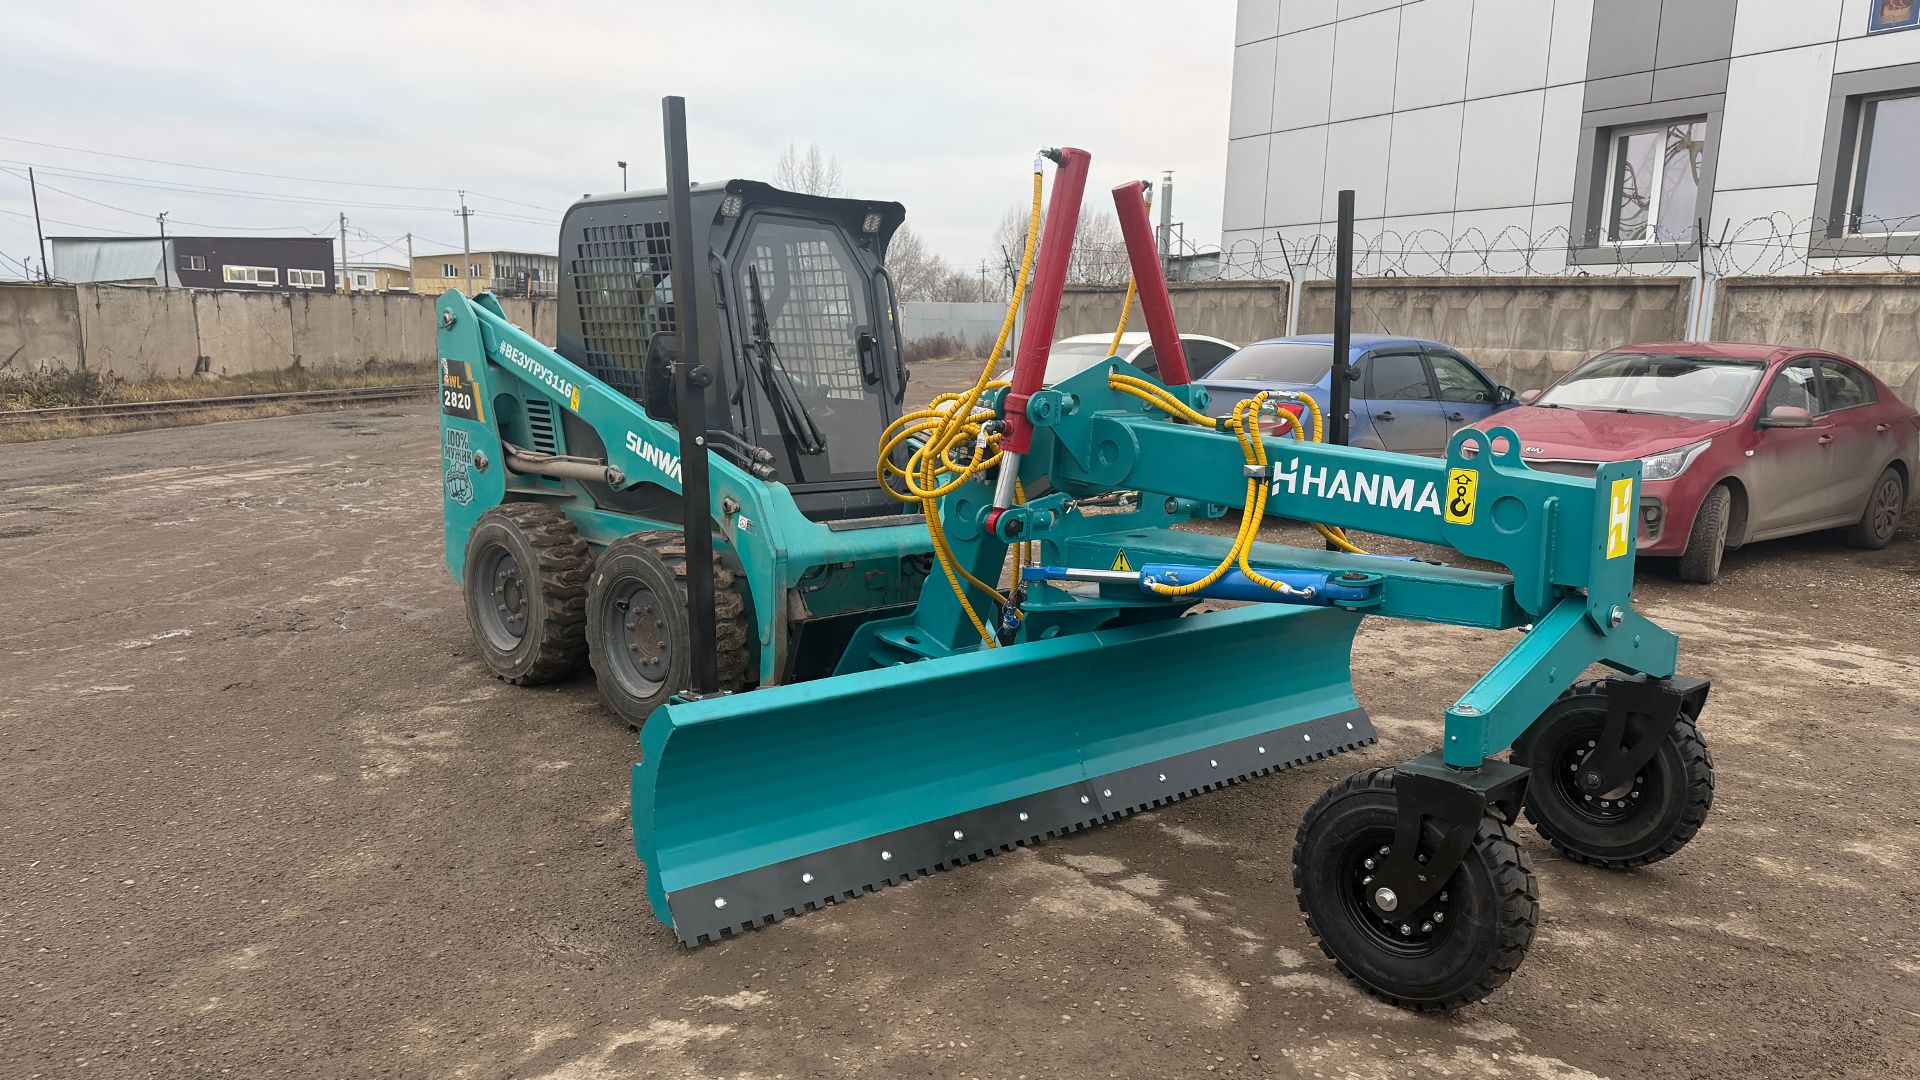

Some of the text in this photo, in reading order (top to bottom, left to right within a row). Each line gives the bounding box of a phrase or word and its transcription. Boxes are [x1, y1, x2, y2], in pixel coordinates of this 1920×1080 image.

[444, 390, 471, 410] 2820
[447, 429, 469, 450] 100%
[444, 445, 472, 464] МУЖИК
[1301, 464, 1442, 516] HANMA
